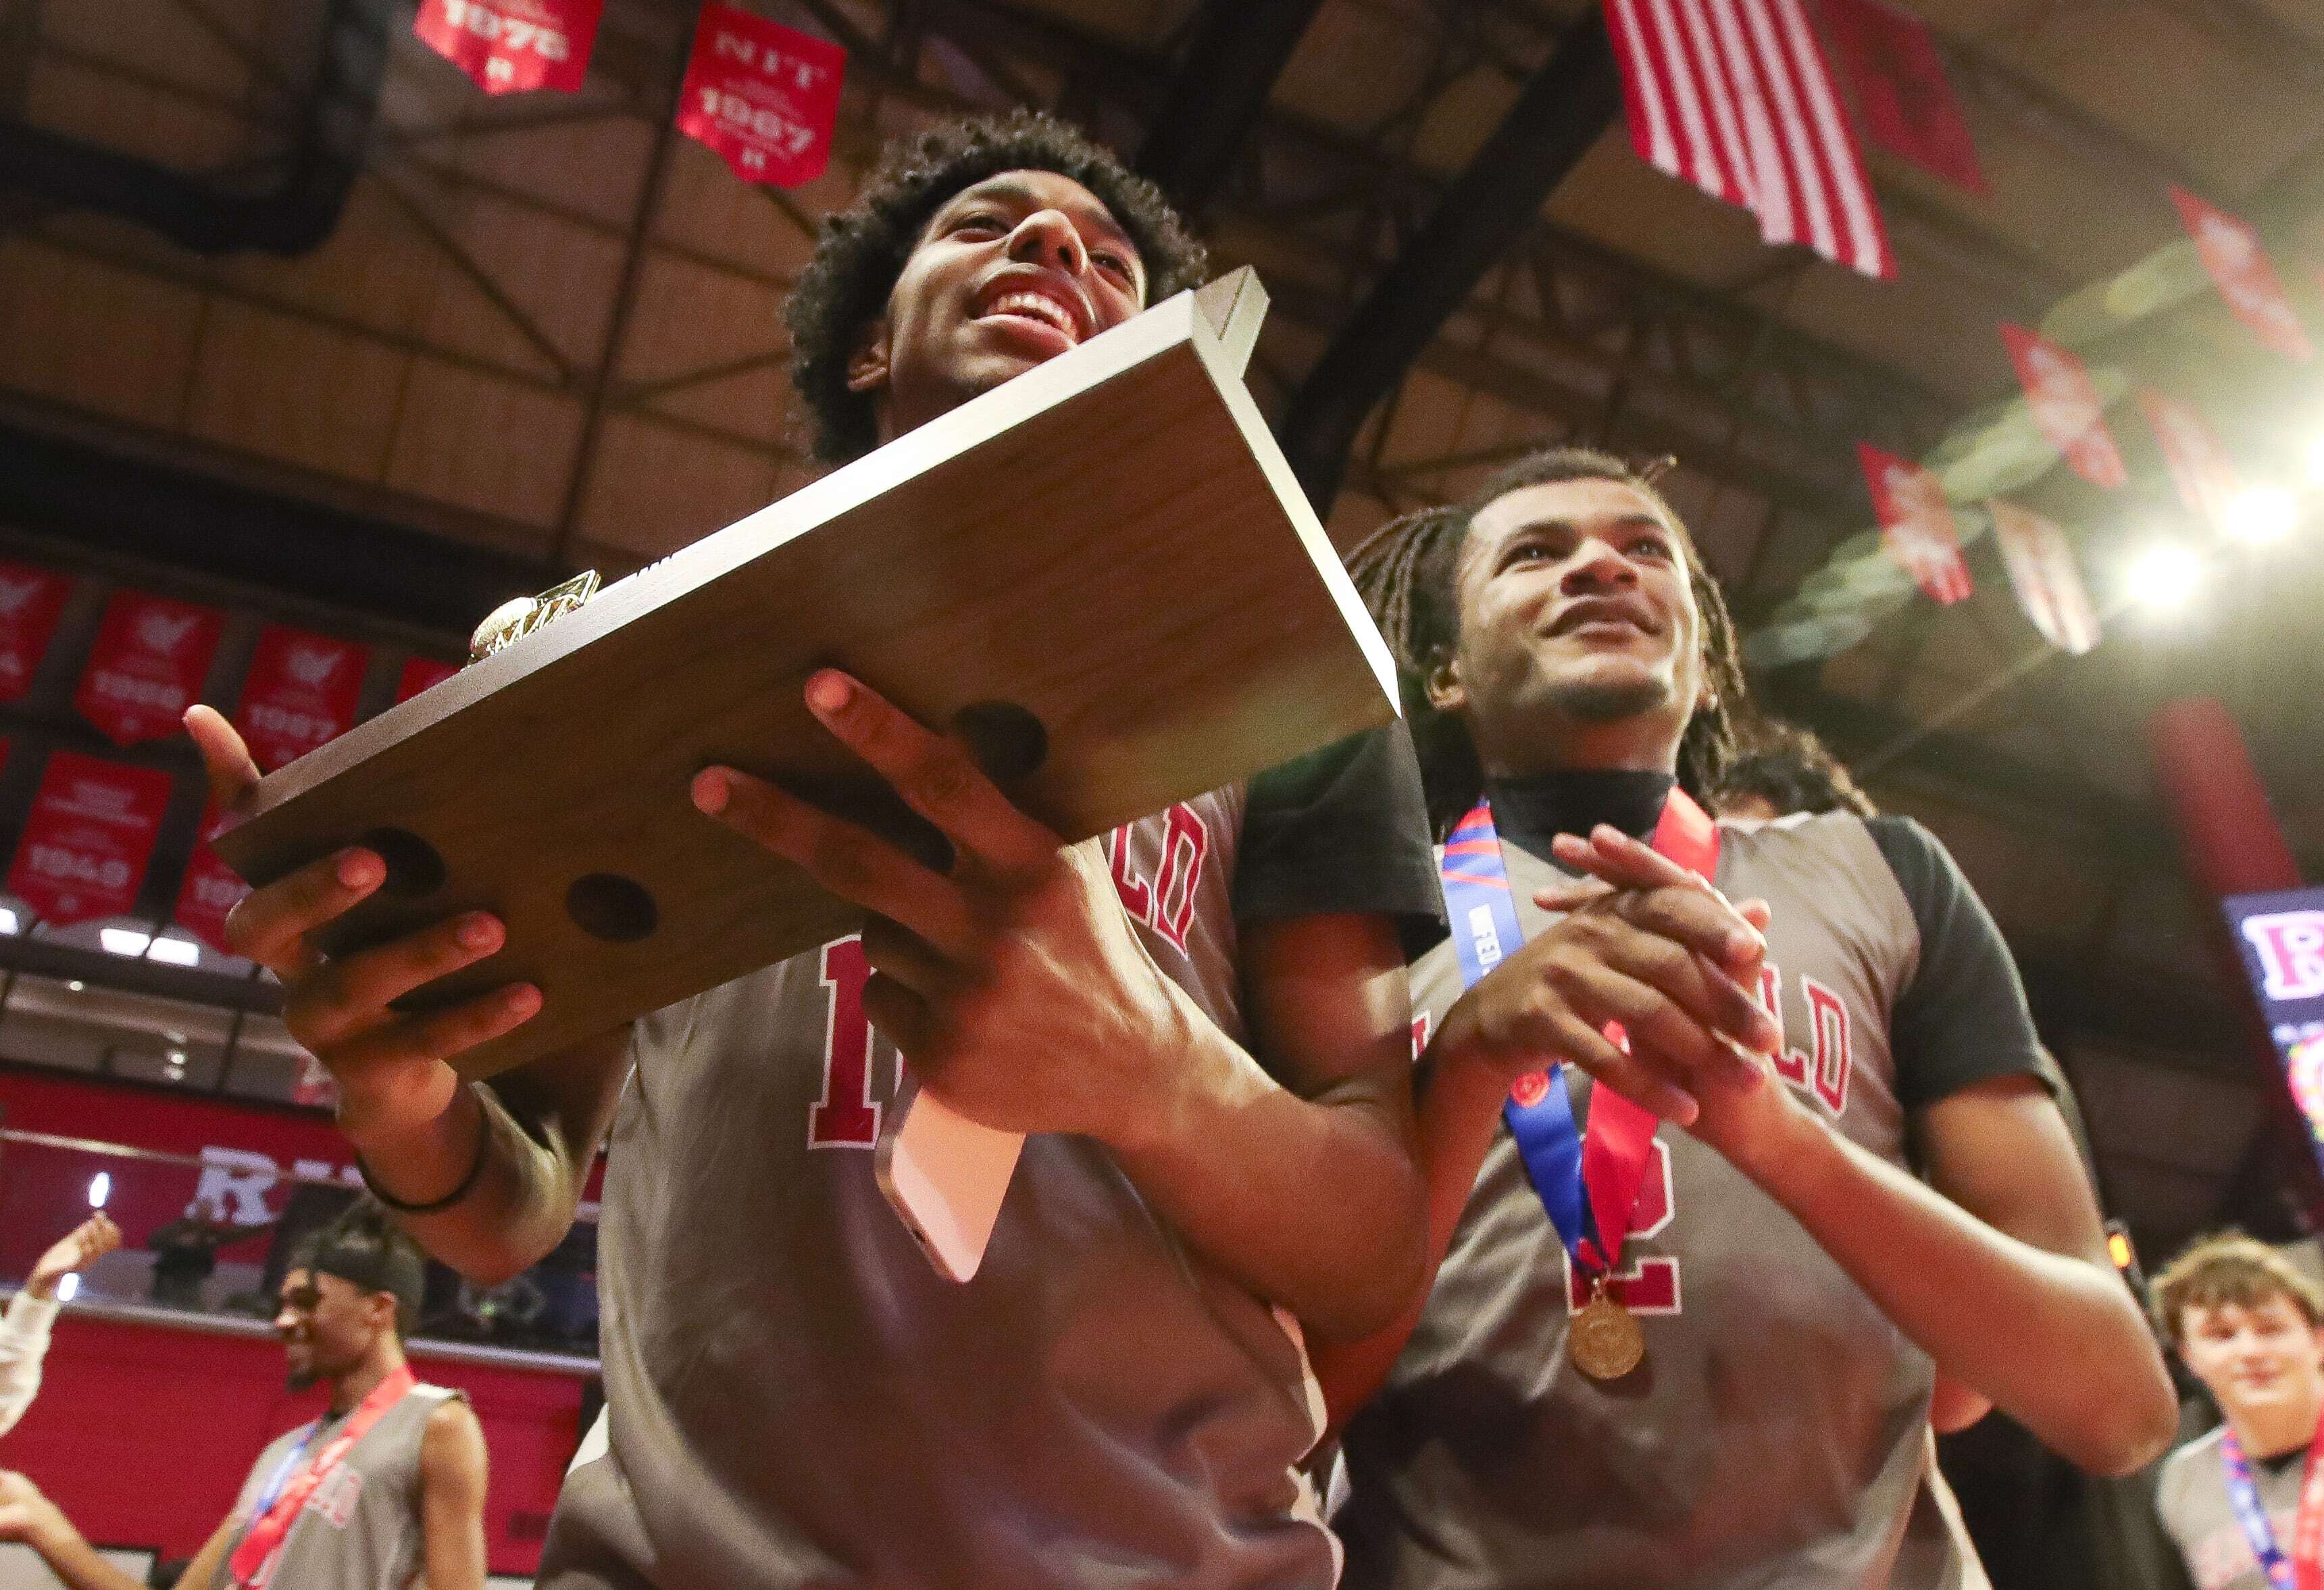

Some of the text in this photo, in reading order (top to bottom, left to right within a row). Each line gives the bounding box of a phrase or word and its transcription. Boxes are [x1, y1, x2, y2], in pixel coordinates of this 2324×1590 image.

[715, 31, 828, 88] NIT
[1109, 801, 1208, 960] LD
[808, 934, 907, 1150] 1
[1757, 960, 1853, 1119] LD
